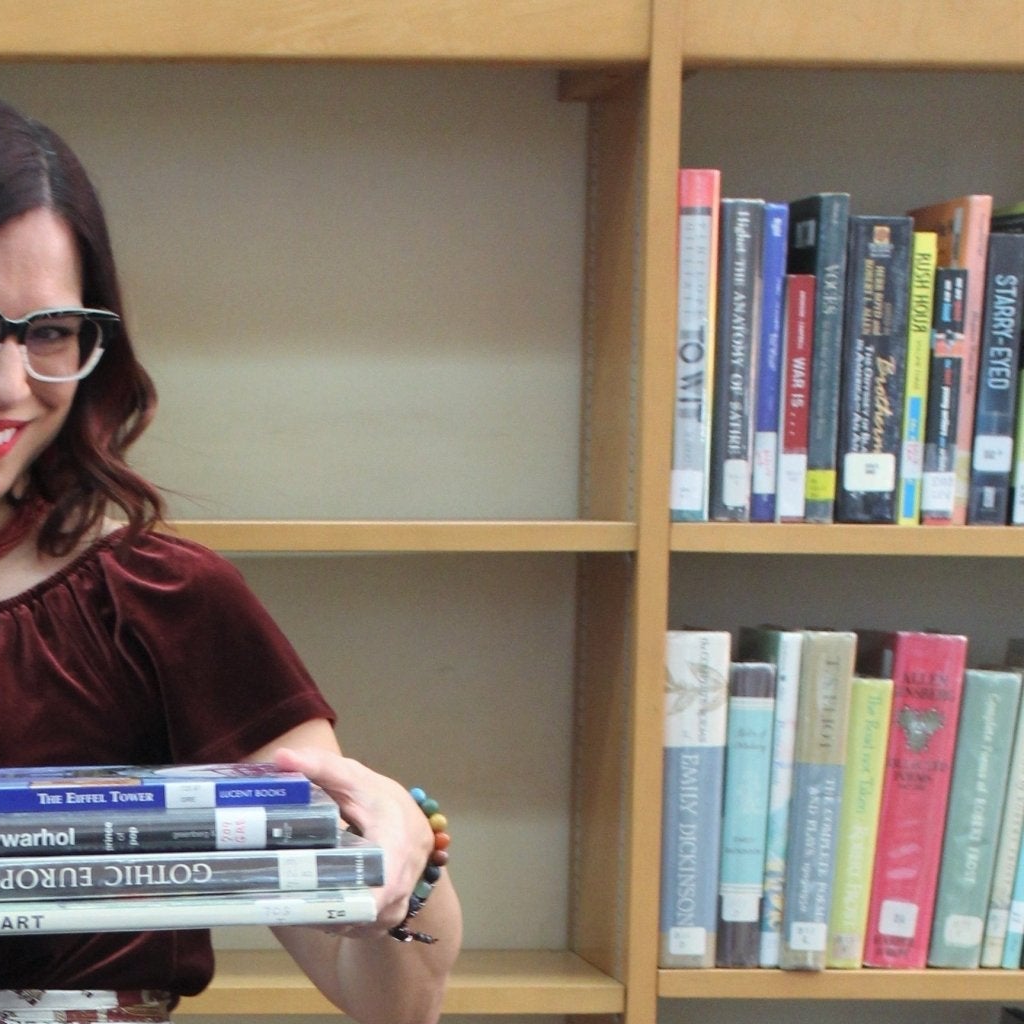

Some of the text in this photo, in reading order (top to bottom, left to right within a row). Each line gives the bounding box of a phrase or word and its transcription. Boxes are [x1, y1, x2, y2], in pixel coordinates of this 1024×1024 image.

[734, 260, 747, 285] THE
[910, 252, 931, 332] RUSH HOUR
[729, 291, 747, 366] ANATOMY
[984, 273, 1020, 390] STARRY-EYED
[729, 373, 742, 394] OF
[790, 357, 806, 407] WAR IS
[867, 354, 897, 454] Brotherm
[726, 401, 742, 455] SATIRE
[866, 694, 881, 718] The
[980, 691, 1000, 741] Complete
[863, 718, 879, 750] Road
[37, 790, 154, 805] THE EIFFEL TOWER
[219, 788, 286, 799] LUCENT BOOKS
[855, 777, 873, 815] Taken
[104, 821, 114, 851] prince
[128, 826, 139, 846] pop
[968, 796, 986, 842] ROBERT
[117, 832, 125, 842] of
[676, 754, 700, 926] EMILY DICKINSON
[104, 864, 213, 887] GOTHIC
[962, 846, 979, 884] FROST
[1, 915, 44, 930] ART
